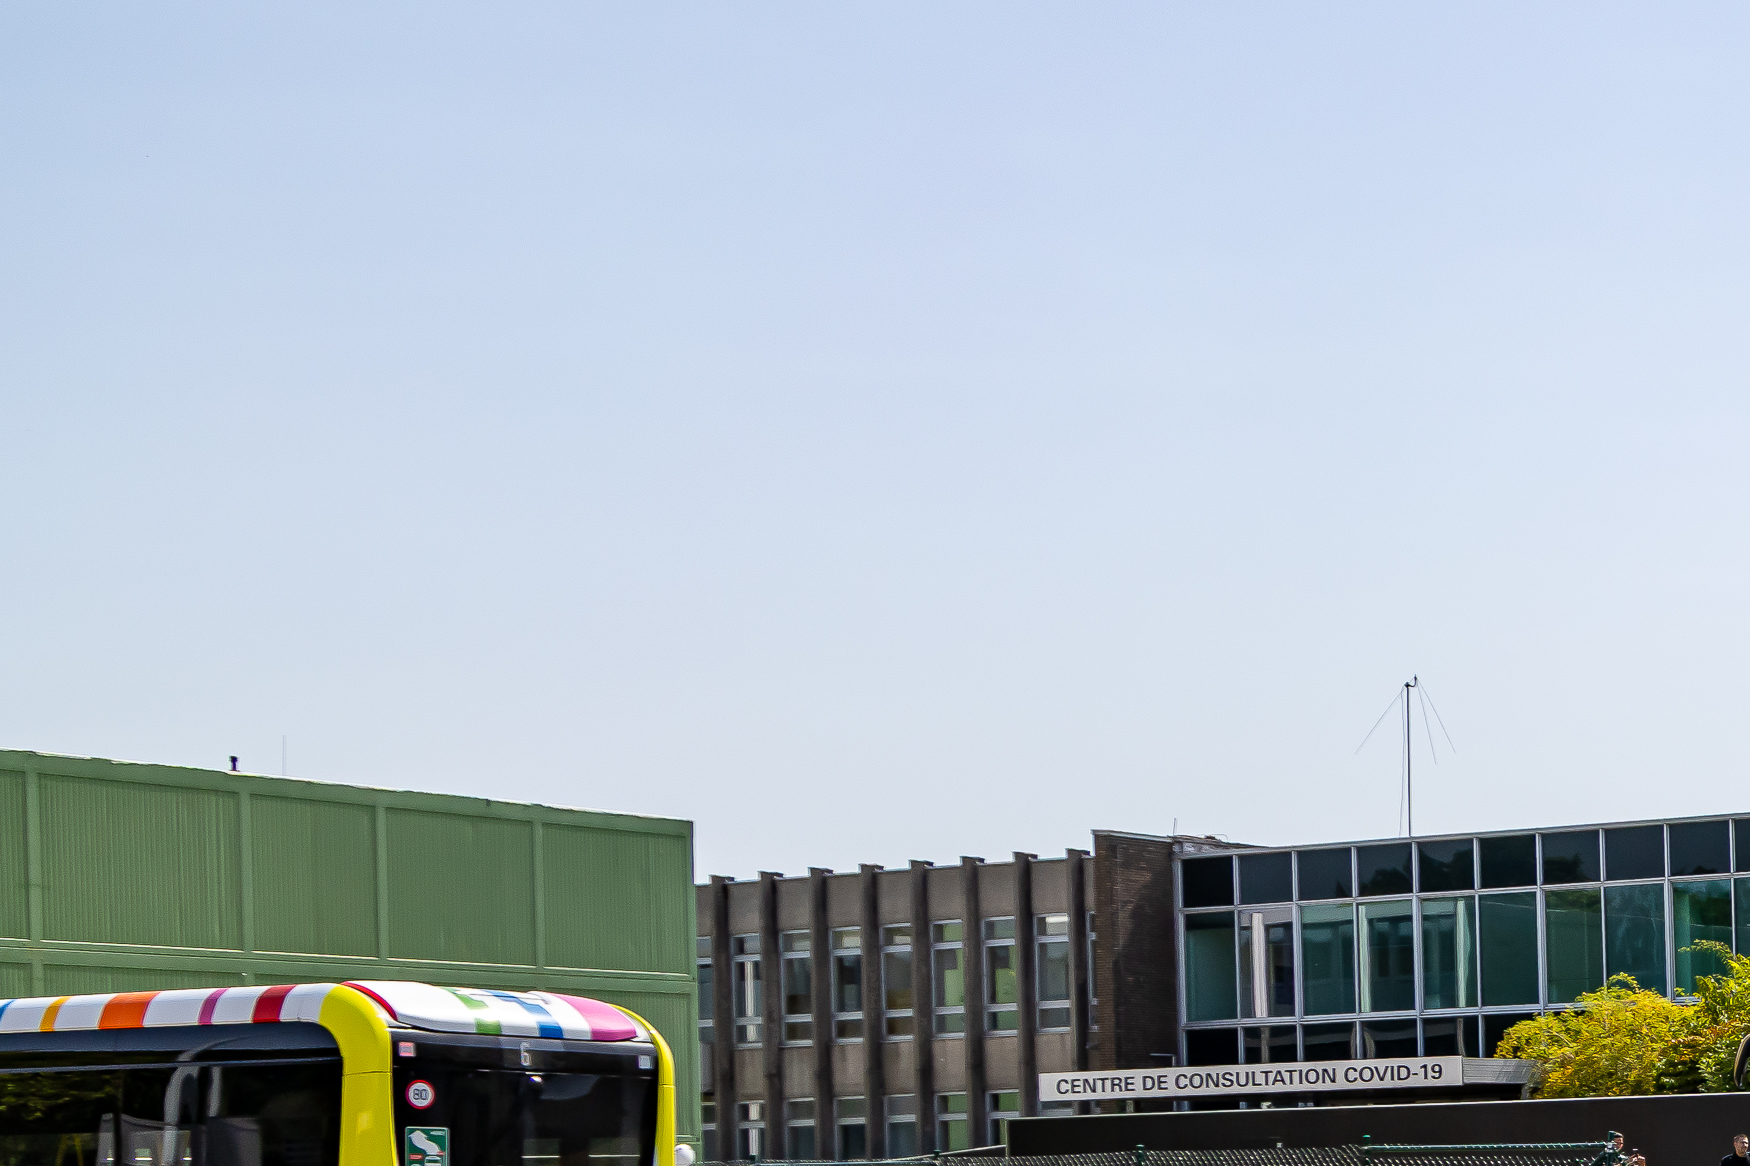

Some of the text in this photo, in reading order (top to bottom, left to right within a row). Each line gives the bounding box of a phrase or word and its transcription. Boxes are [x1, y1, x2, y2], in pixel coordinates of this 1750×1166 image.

[1056, 1063, 1443, 1094] CENTRE DE CONSULTATION COVID-19
[413, 1089, 428, 1100] 80
